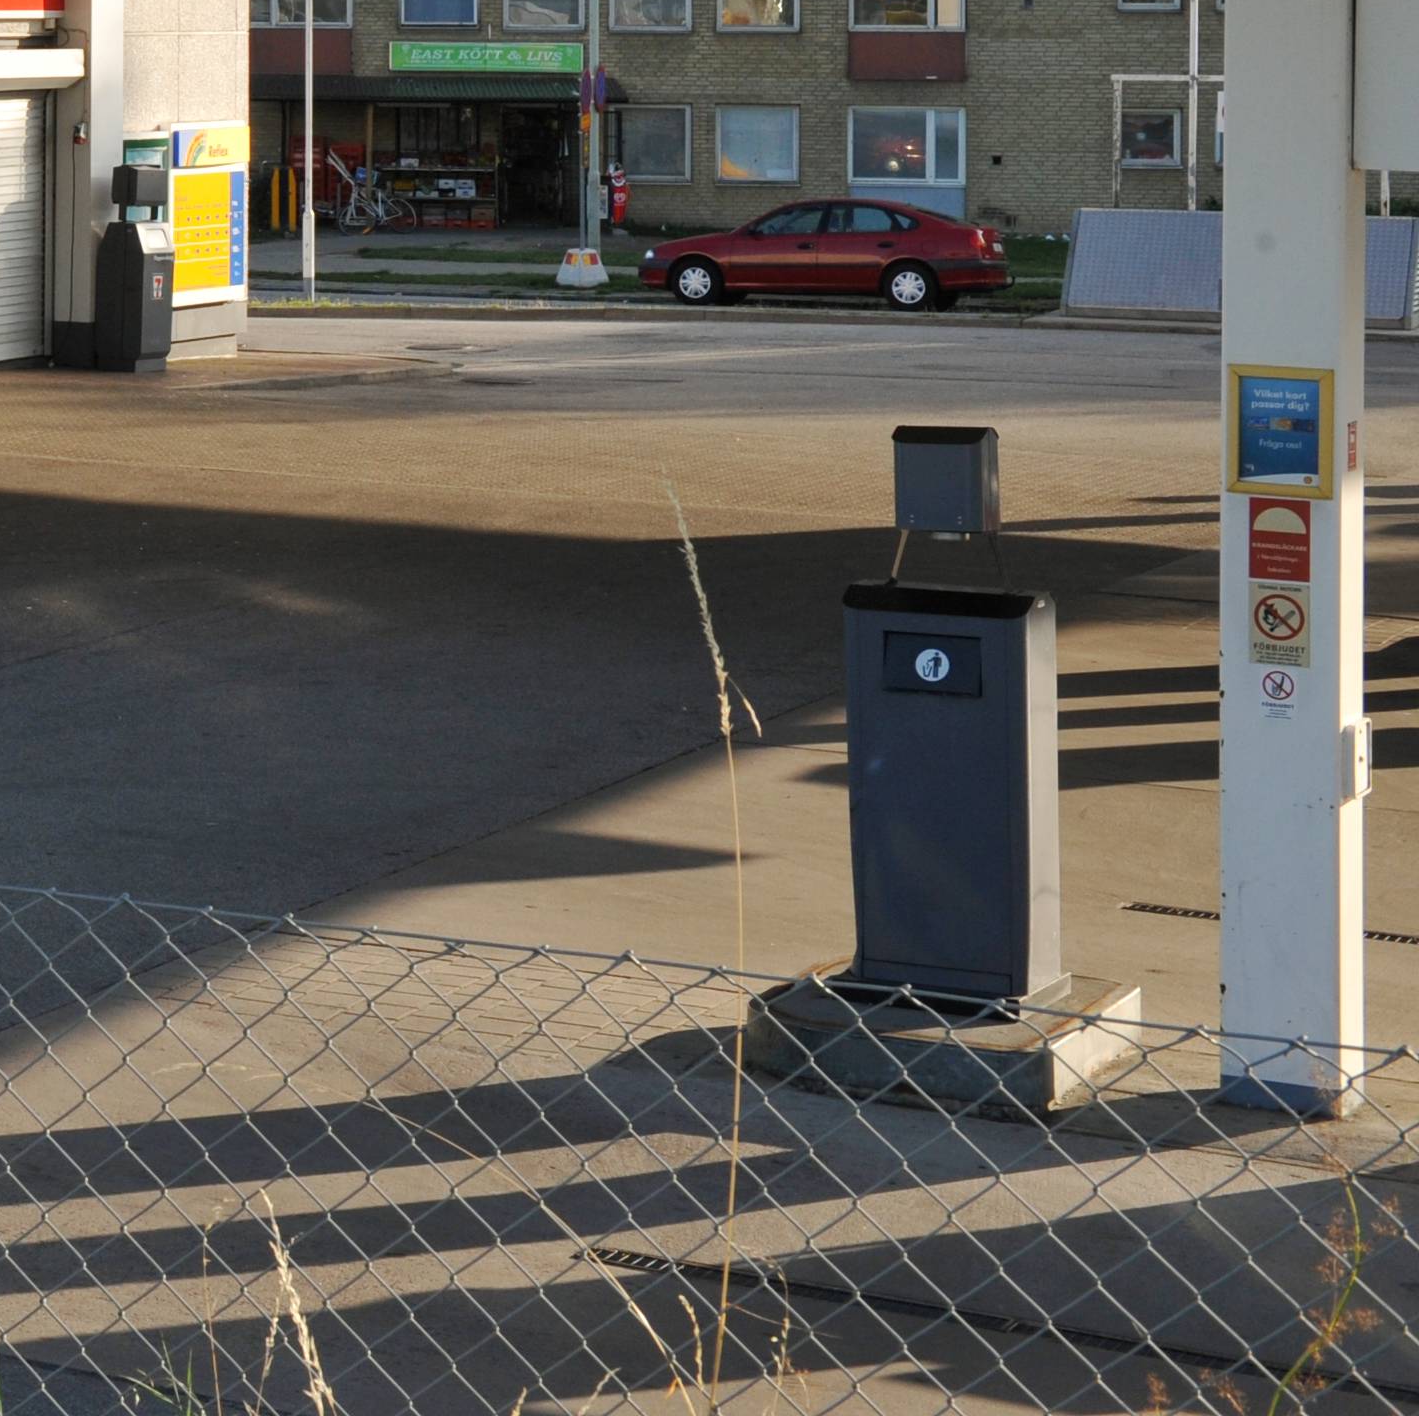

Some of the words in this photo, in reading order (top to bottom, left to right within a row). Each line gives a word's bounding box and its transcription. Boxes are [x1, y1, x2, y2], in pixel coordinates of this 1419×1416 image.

[411, 49, 454, 60] EAST
[458, 47, 503, 60] KÖTT
[507, 50, 521, 61] &
[526, 51, 563, 62] LIVS
